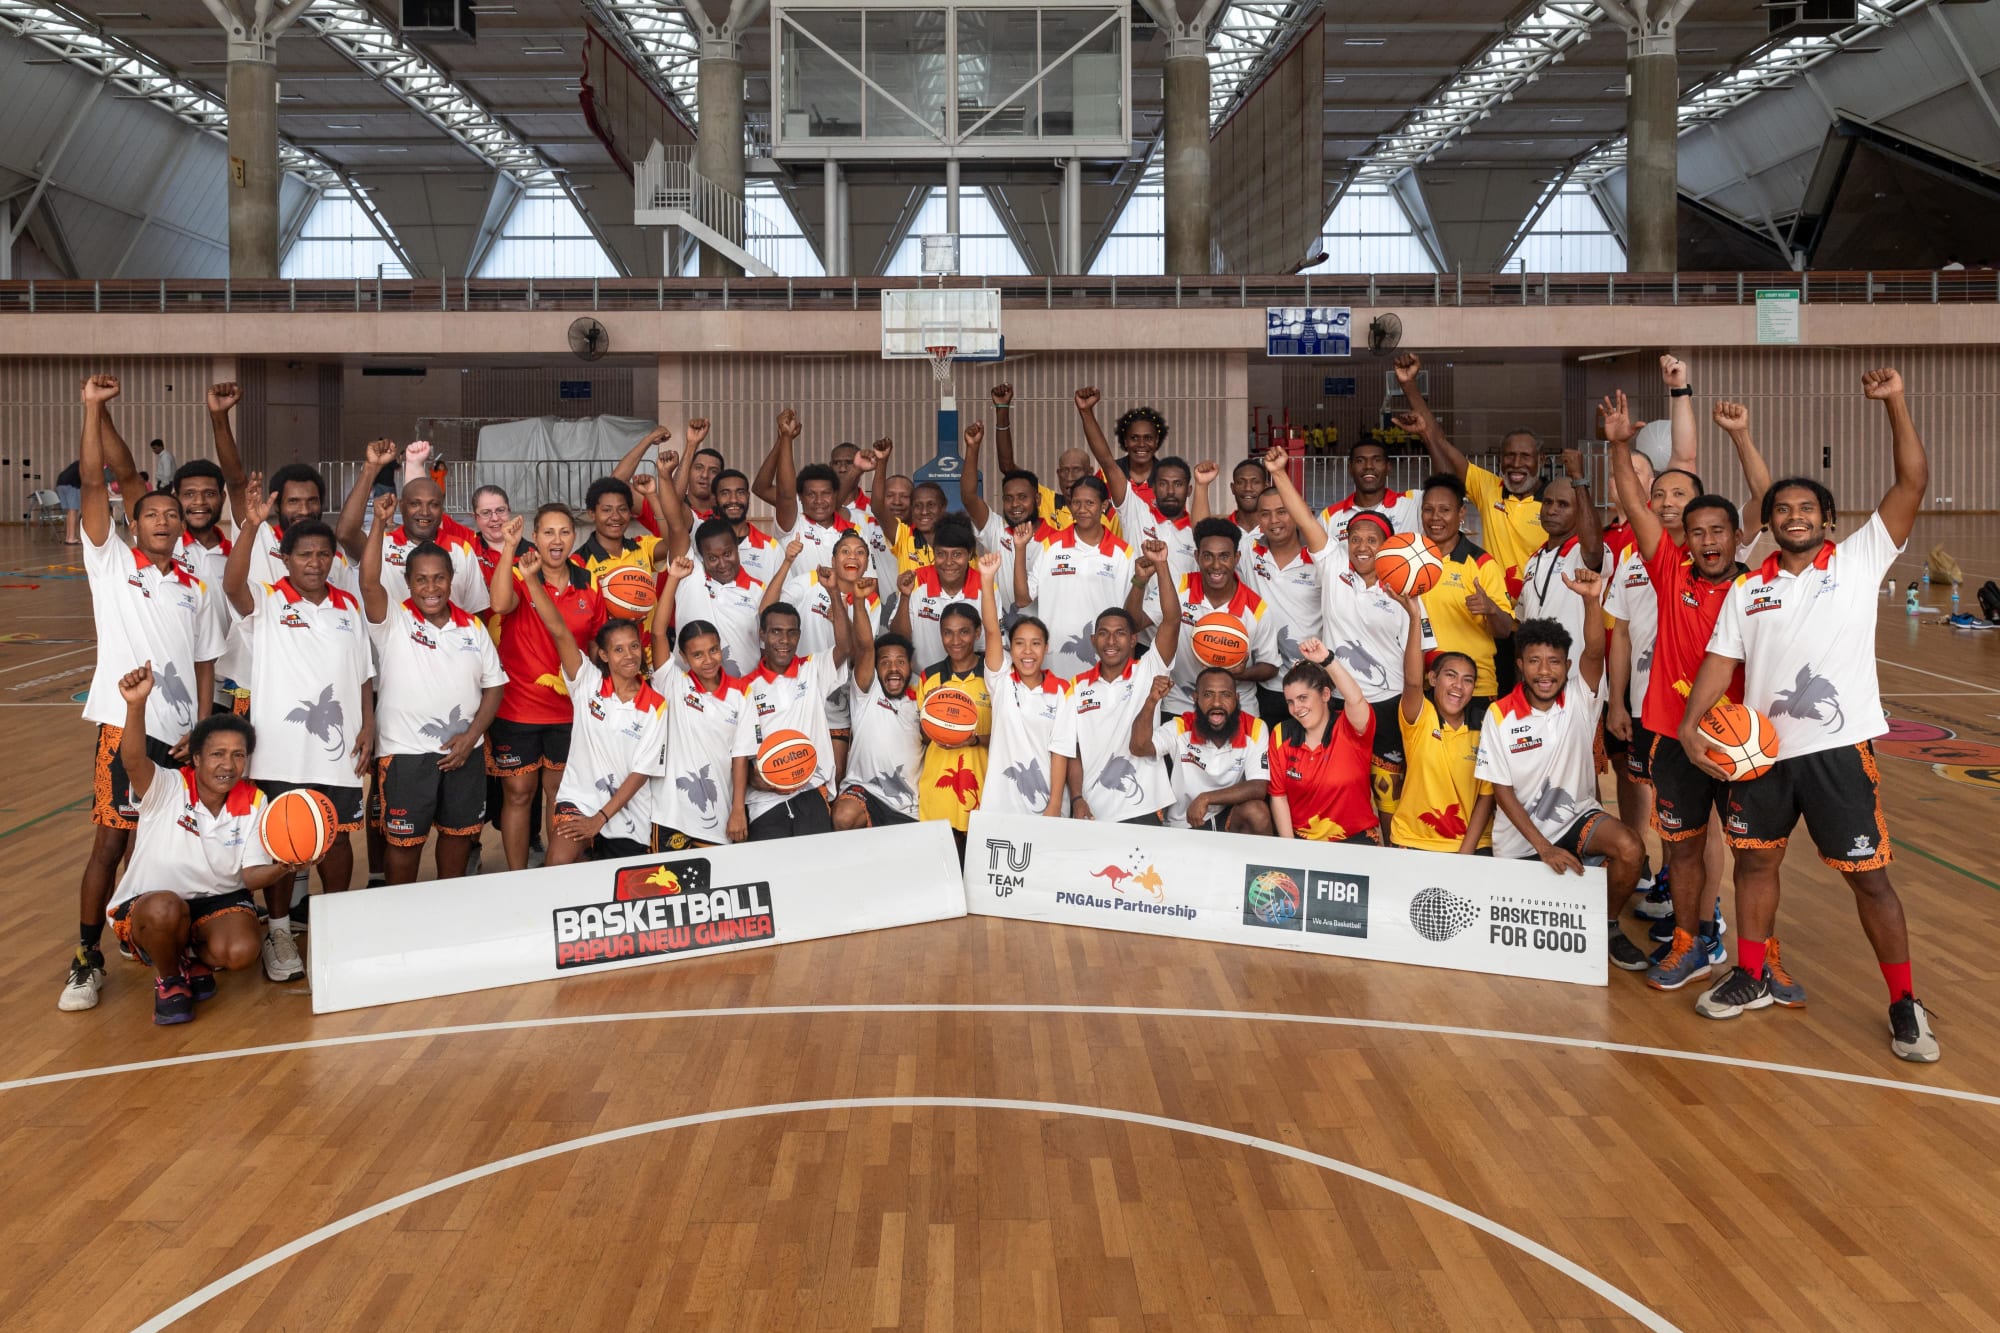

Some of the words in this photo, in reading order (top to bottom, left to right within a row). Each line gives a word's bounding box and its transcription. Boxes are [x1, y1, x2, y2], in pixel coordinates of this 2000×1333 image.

[623, 574, 655, 590] molten
[1203, 634, 1240, 649] molten
[937, 691, 974, 706] molten
[771, 747, 809, 768] molten
[319, 798, 335, 845] molten
[986, 838, 1032, 873] TU
[987, 873, 1025, 888] TEAM
[995, 886, 1013, 898] UP
[1316, 879, 1359, 904] FIBA
[556, 885, 770, 943] BASKETBALL
[1056, 891, 1112, 909] PNGAus
[1114, 898, 1198, 920] Partnership
[1490, 895, 1513, 903] FIBA
[1521, 898, 1587, 910] FOUNDATION
[1312, 917, 1322, 925] We
[1333, 919, 1362, 929] Basketball
[1490, 905, 1587, 930] BASKETBALL
[558, 935, 635, 965] PAPUA
[639, 926, 691, 954] NEW
[694, 915, 773, 945] GUINEA
[1490, 924, 1528, 947] FOR
[1533, 928, 1587, 954] GOOD
